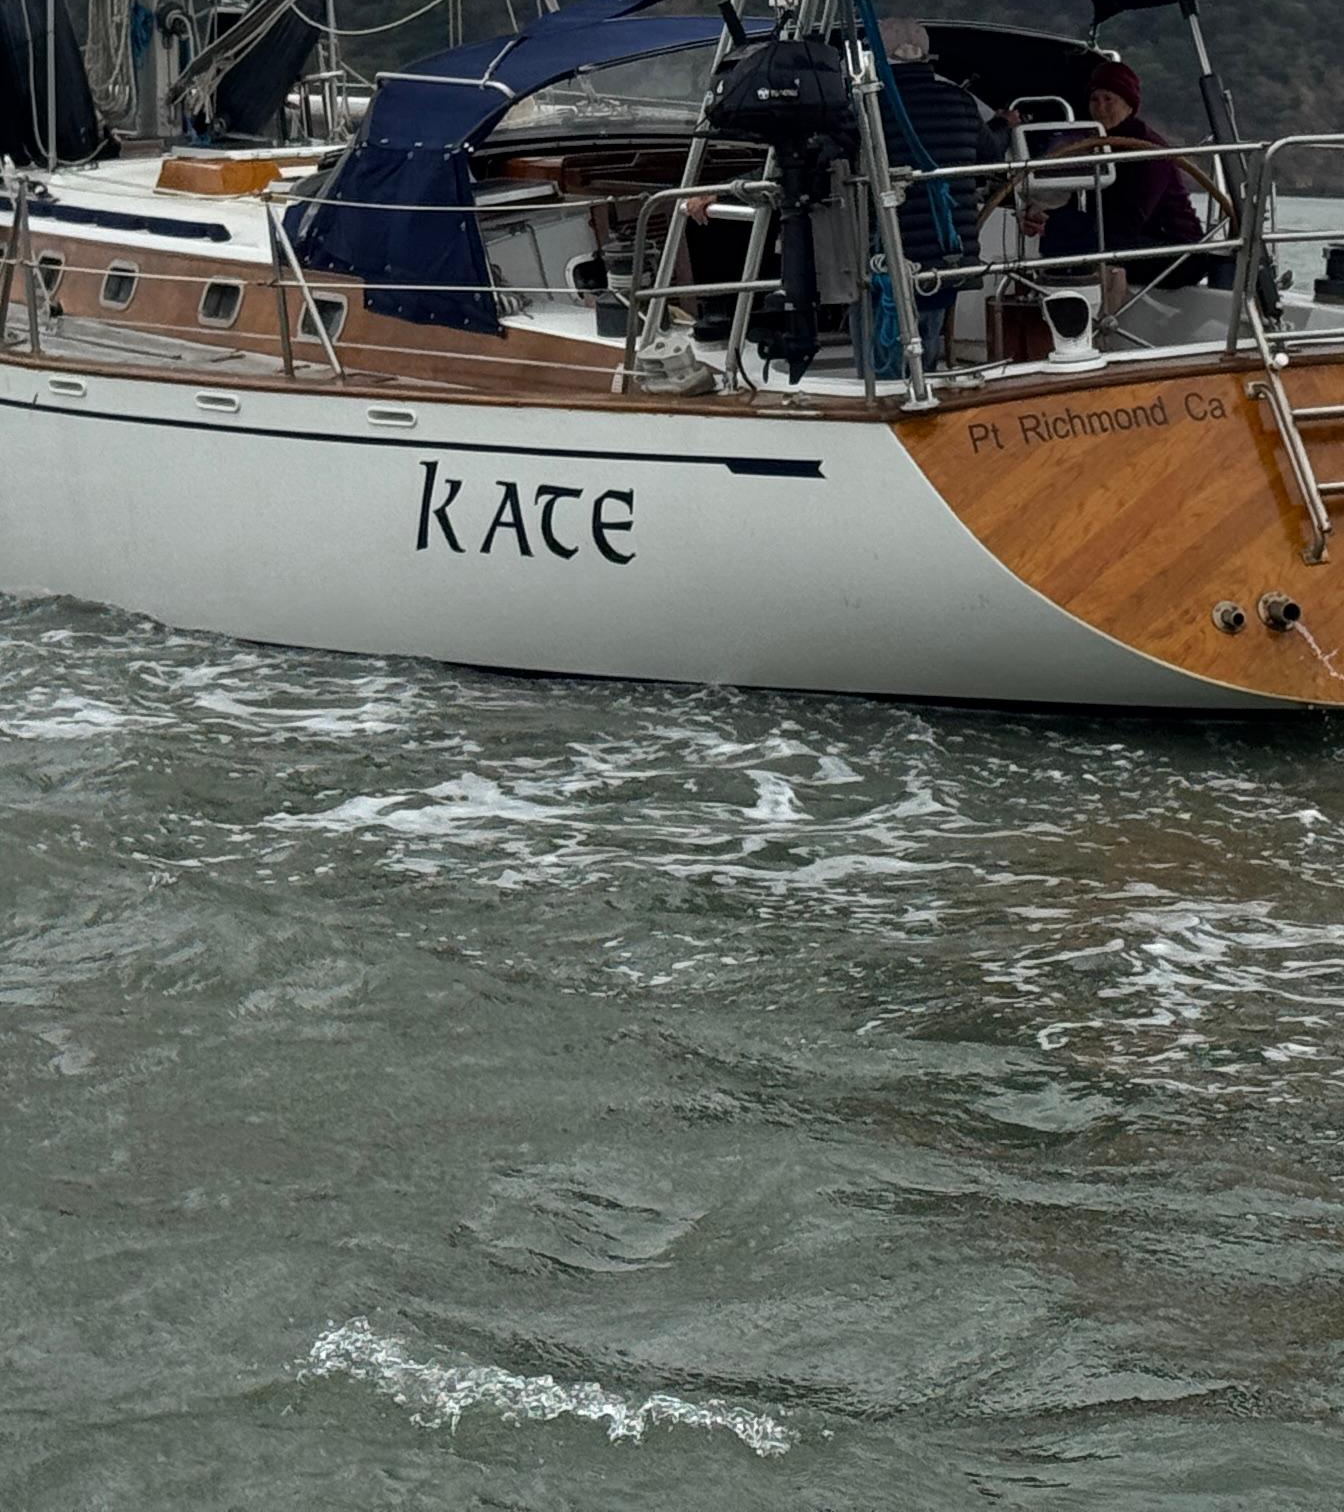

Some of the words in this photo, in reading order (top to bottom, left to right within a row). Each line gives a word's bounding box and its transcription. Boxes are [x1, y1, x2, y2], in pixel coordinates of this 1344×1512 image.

[968, 422, 1004, 454] Pt
[1018, 396, 1169, 444] Richmond
[1184, 392, 1227, 422] Ca
[416, 460, 637, 565] KATE
